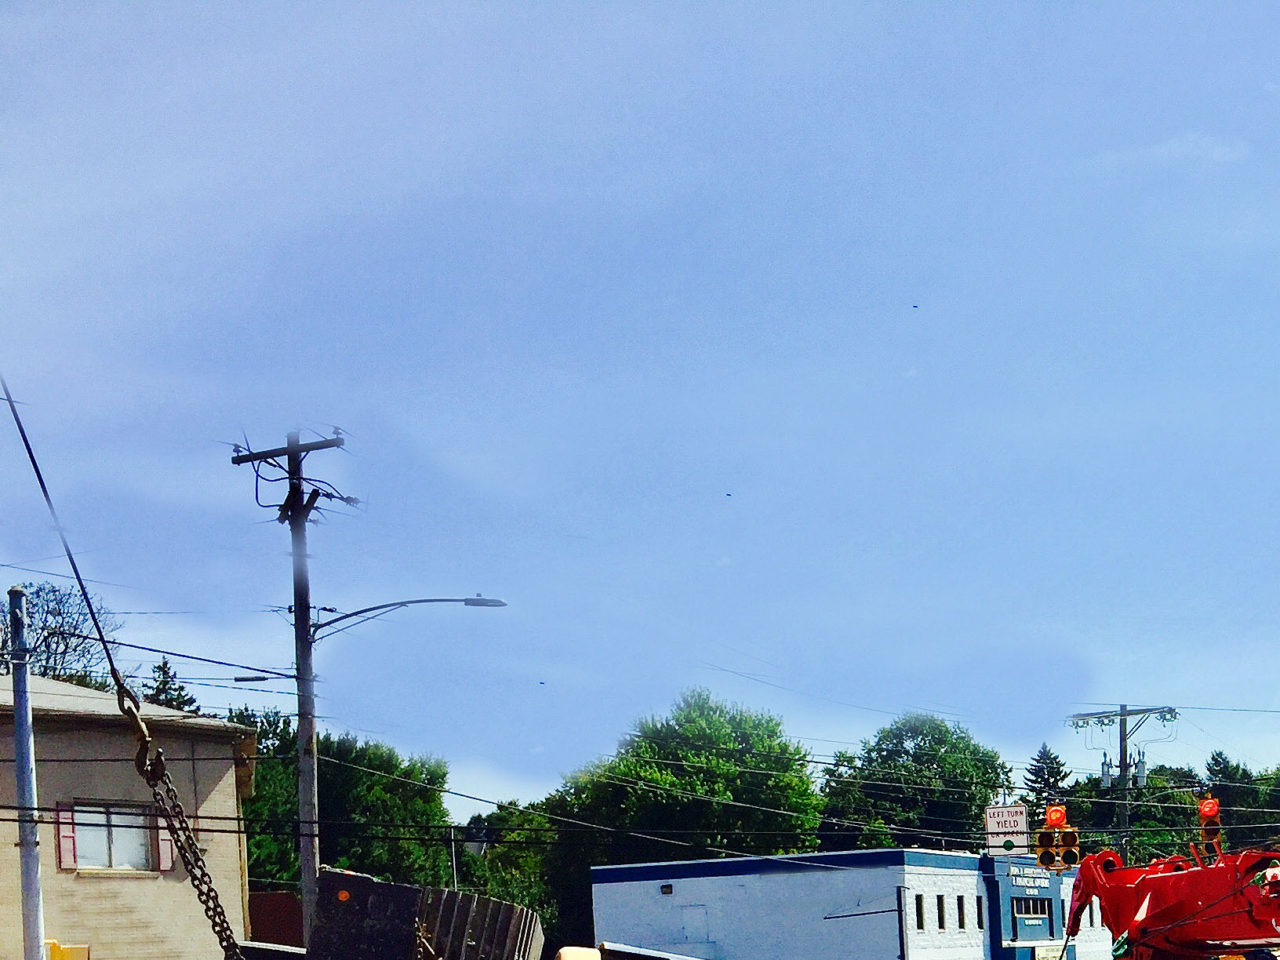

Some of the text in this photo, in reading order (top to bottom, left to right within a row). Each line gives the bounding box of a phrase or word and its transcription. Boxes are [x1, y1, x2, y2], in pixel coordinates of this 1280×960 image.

[988, 810, 1024, 819] LEFT TURN
[995, 820, 1019, 829] YIELD
